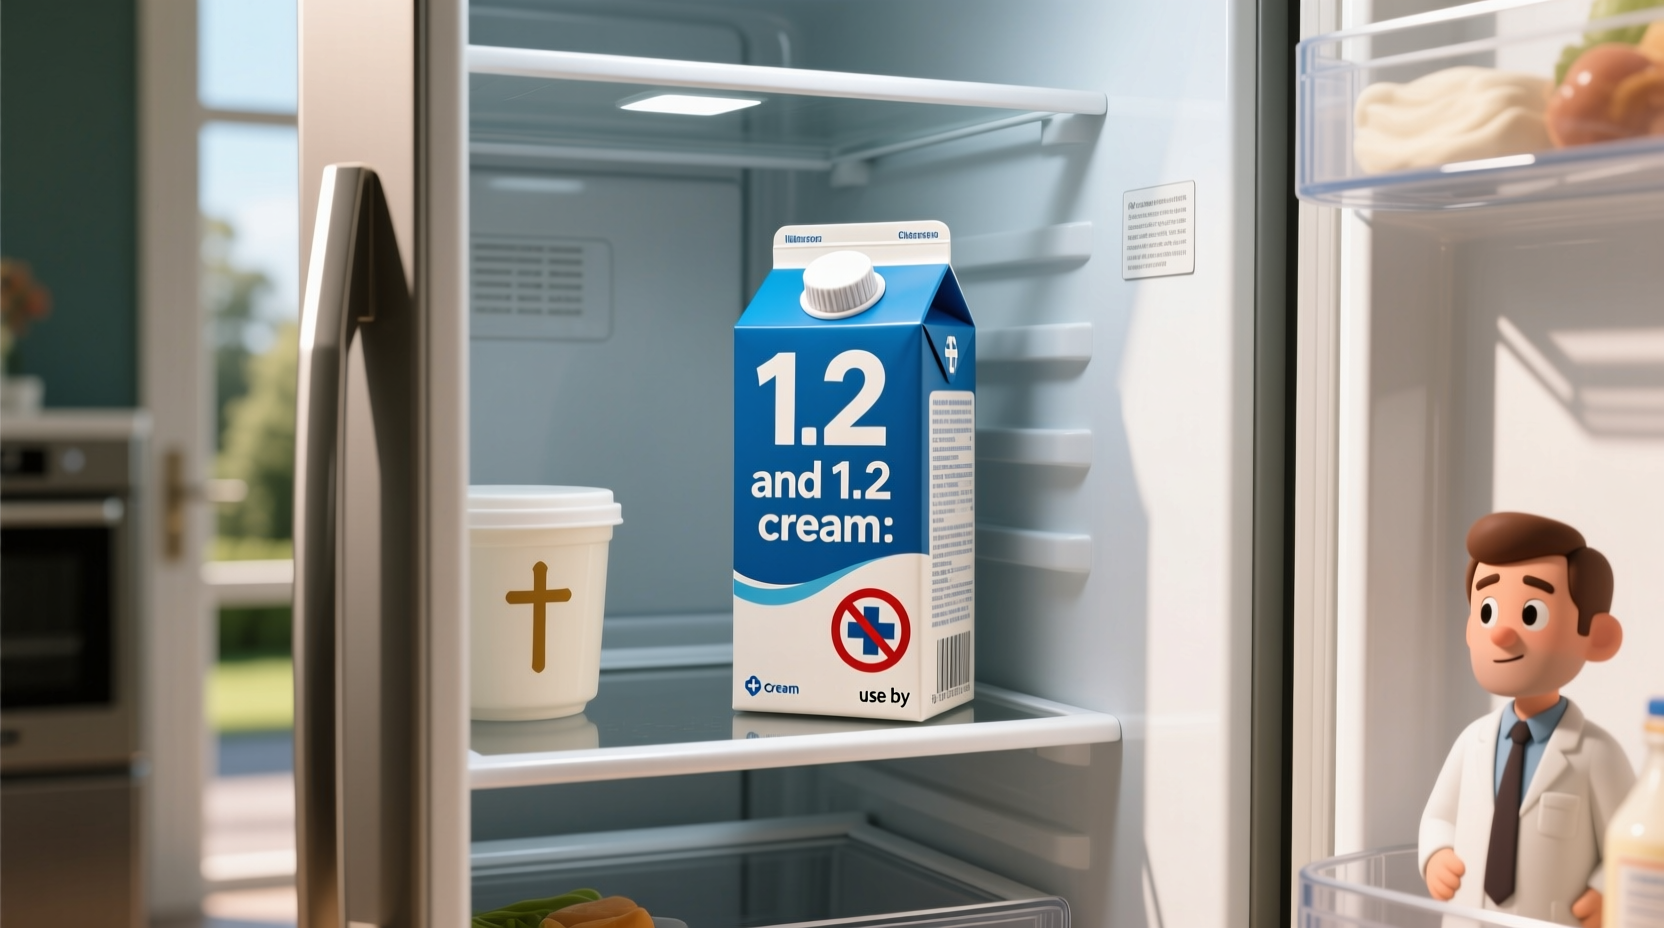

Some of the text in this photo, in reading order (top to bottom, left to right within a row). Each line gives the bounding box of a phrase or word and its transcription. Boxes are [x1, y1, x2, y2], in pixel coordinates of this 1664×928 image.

[756, 349, 887, 446] 1.2
[751, 460, 891, 500] and 1.2
[758, 513, 894, 543] cream:
[859, 687, 910, 708] use by
